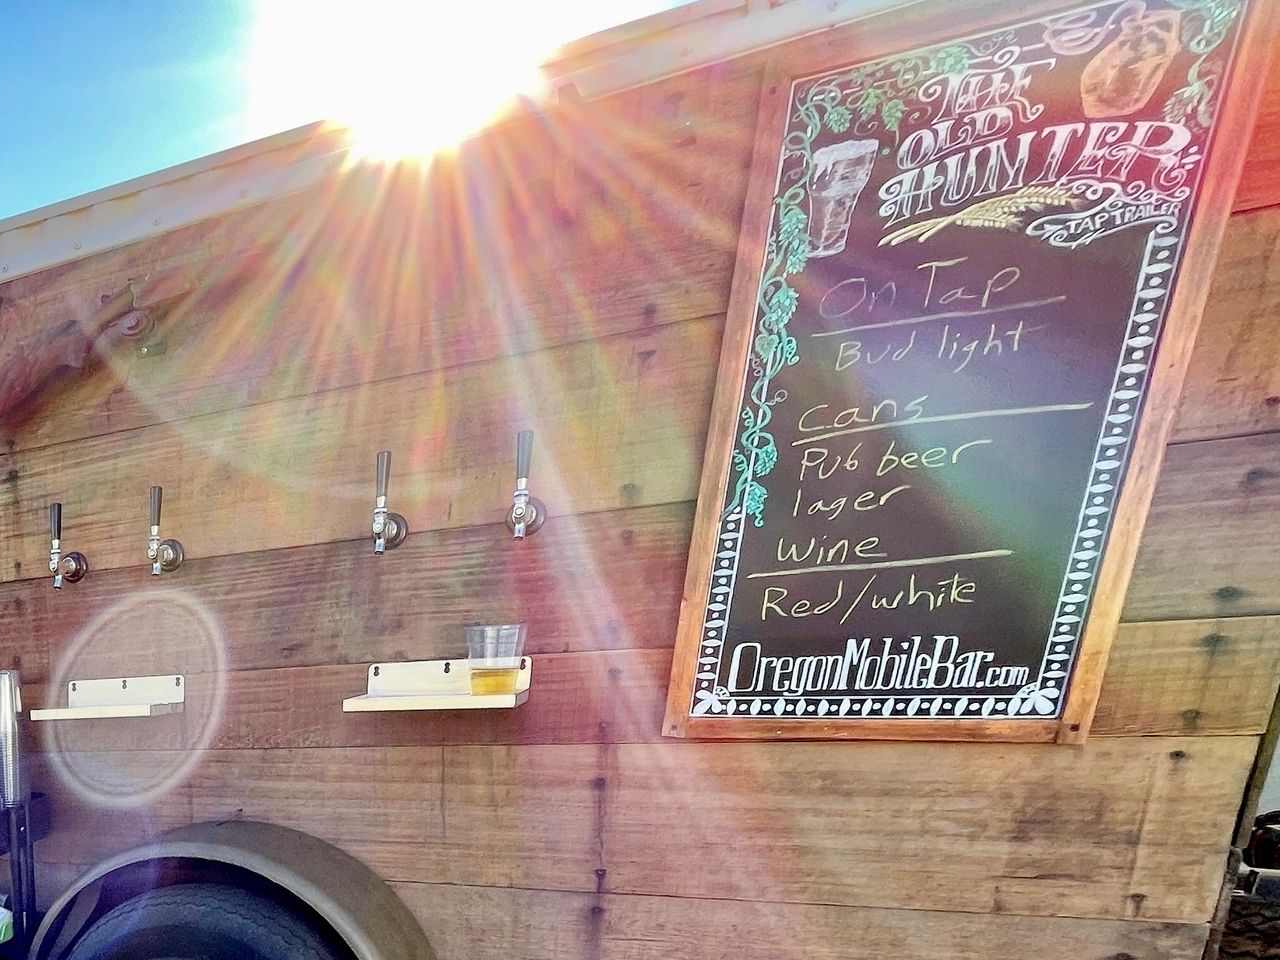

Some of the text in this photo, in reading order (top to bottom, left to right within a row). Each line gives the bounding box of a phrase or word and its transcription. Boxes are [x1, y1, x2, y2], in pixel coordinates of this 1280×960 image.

[919, 45, 1057, 125] THE
[896, 106, 1014, 171] OLD
[877, 120, 1194, 229] HUNTER
[1065, 202, 1181, 235] TAP TRAILER
[819, 256, 1021, 318] On Tap
[834, 320, 1025, 374] Bud light
[875, 438, 993, 477] beer
[792, 485, 911, 522] lager
[726, 634, 1030, 697] OregonMobileBar.com
